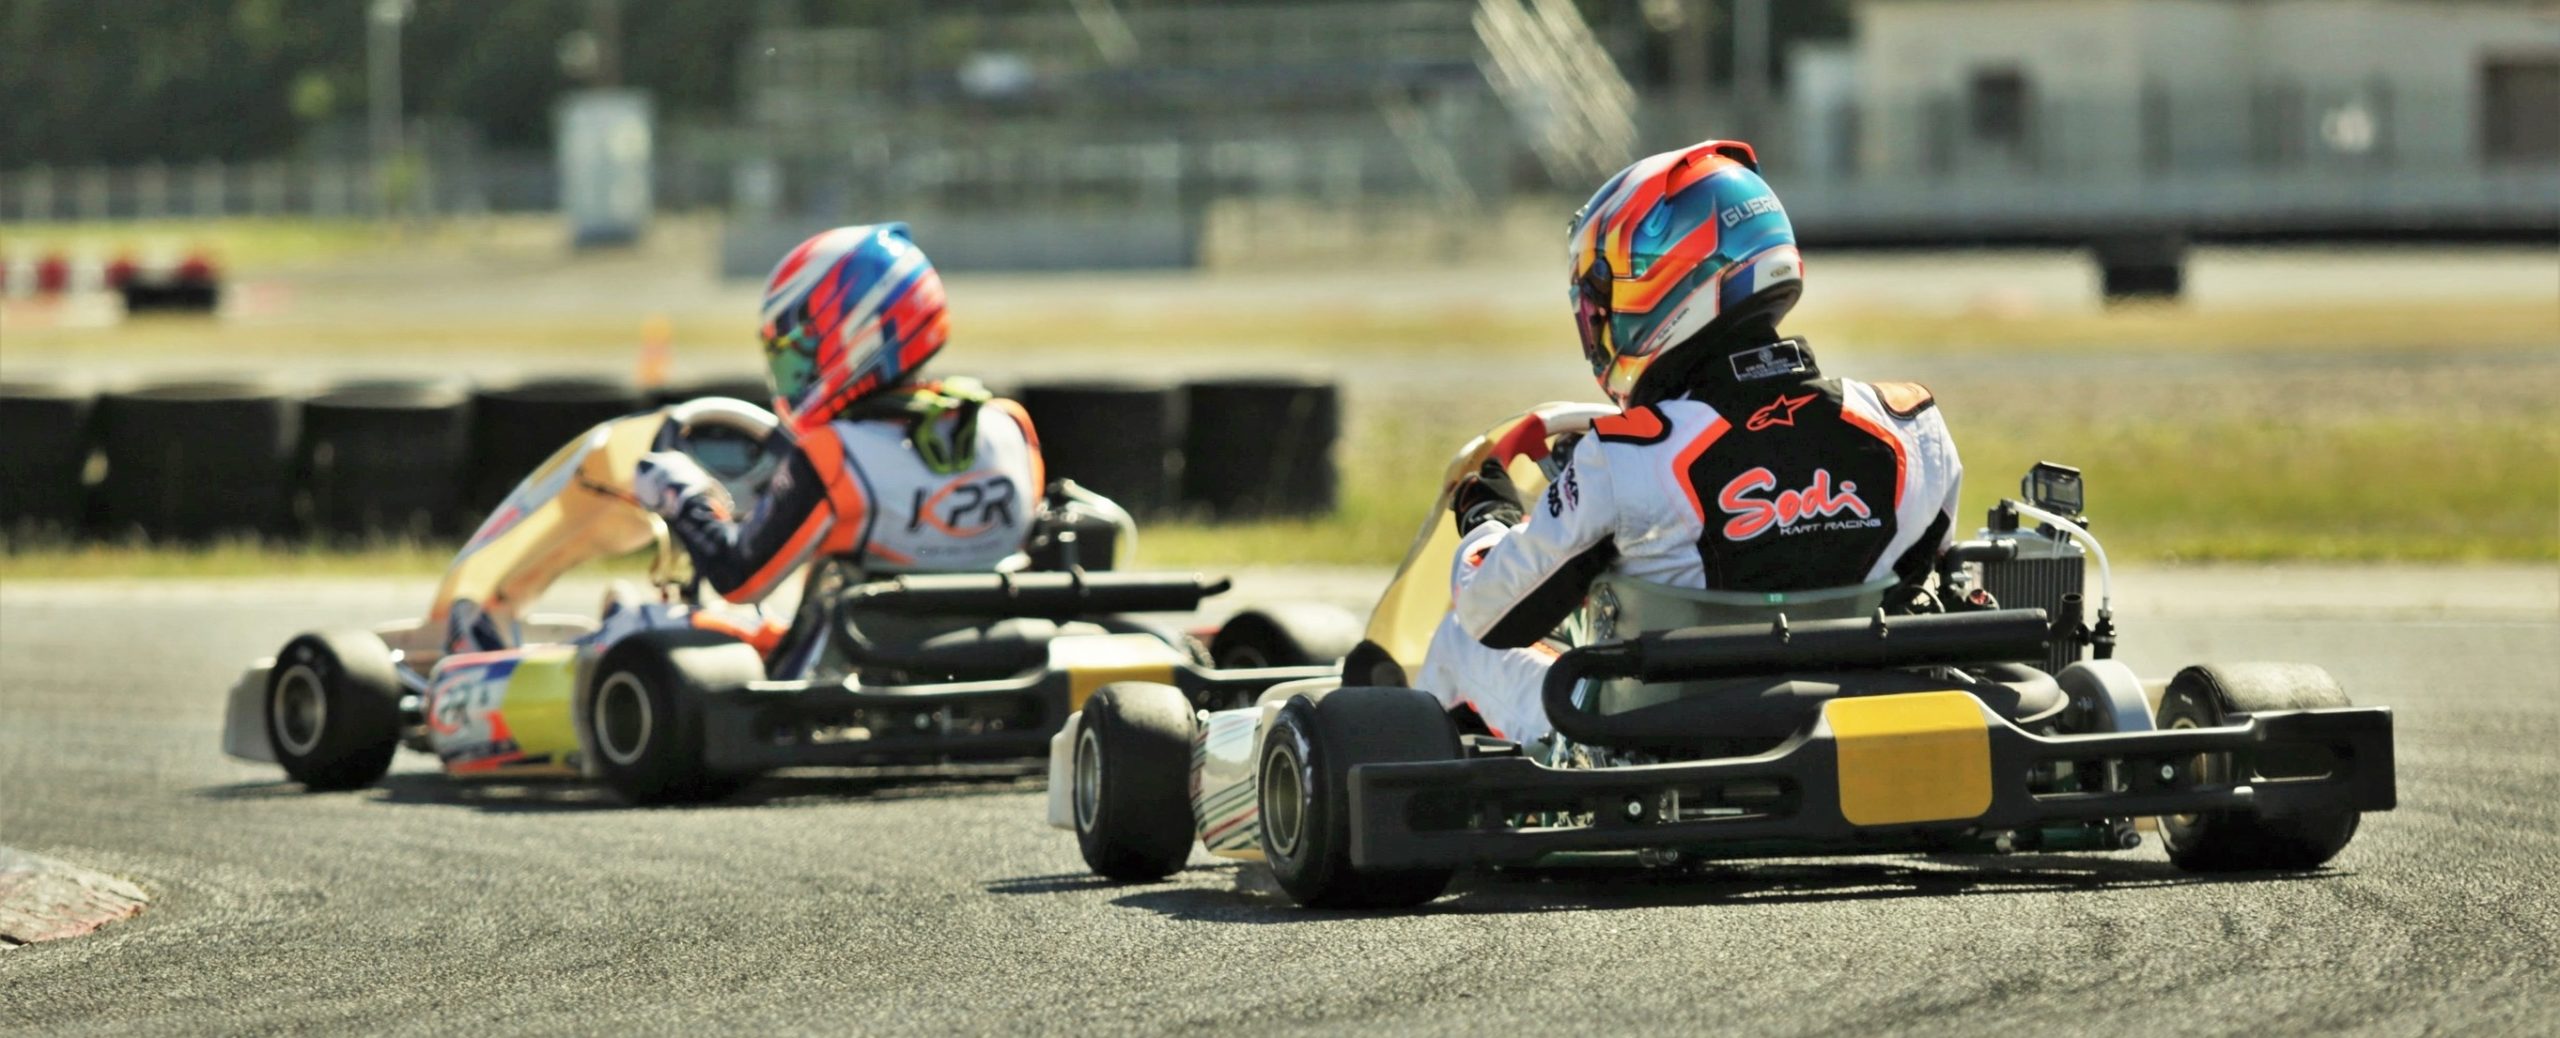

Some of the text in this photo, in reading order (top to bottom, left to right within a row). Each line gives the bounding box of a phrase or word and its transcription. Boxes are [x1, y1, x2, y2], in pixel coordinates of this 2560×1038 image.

[905, 473, 1015, 534] KPR
[1719, 467, 1871, 541] Sodi
[1780, 518, 1881, 536] KART RACING
